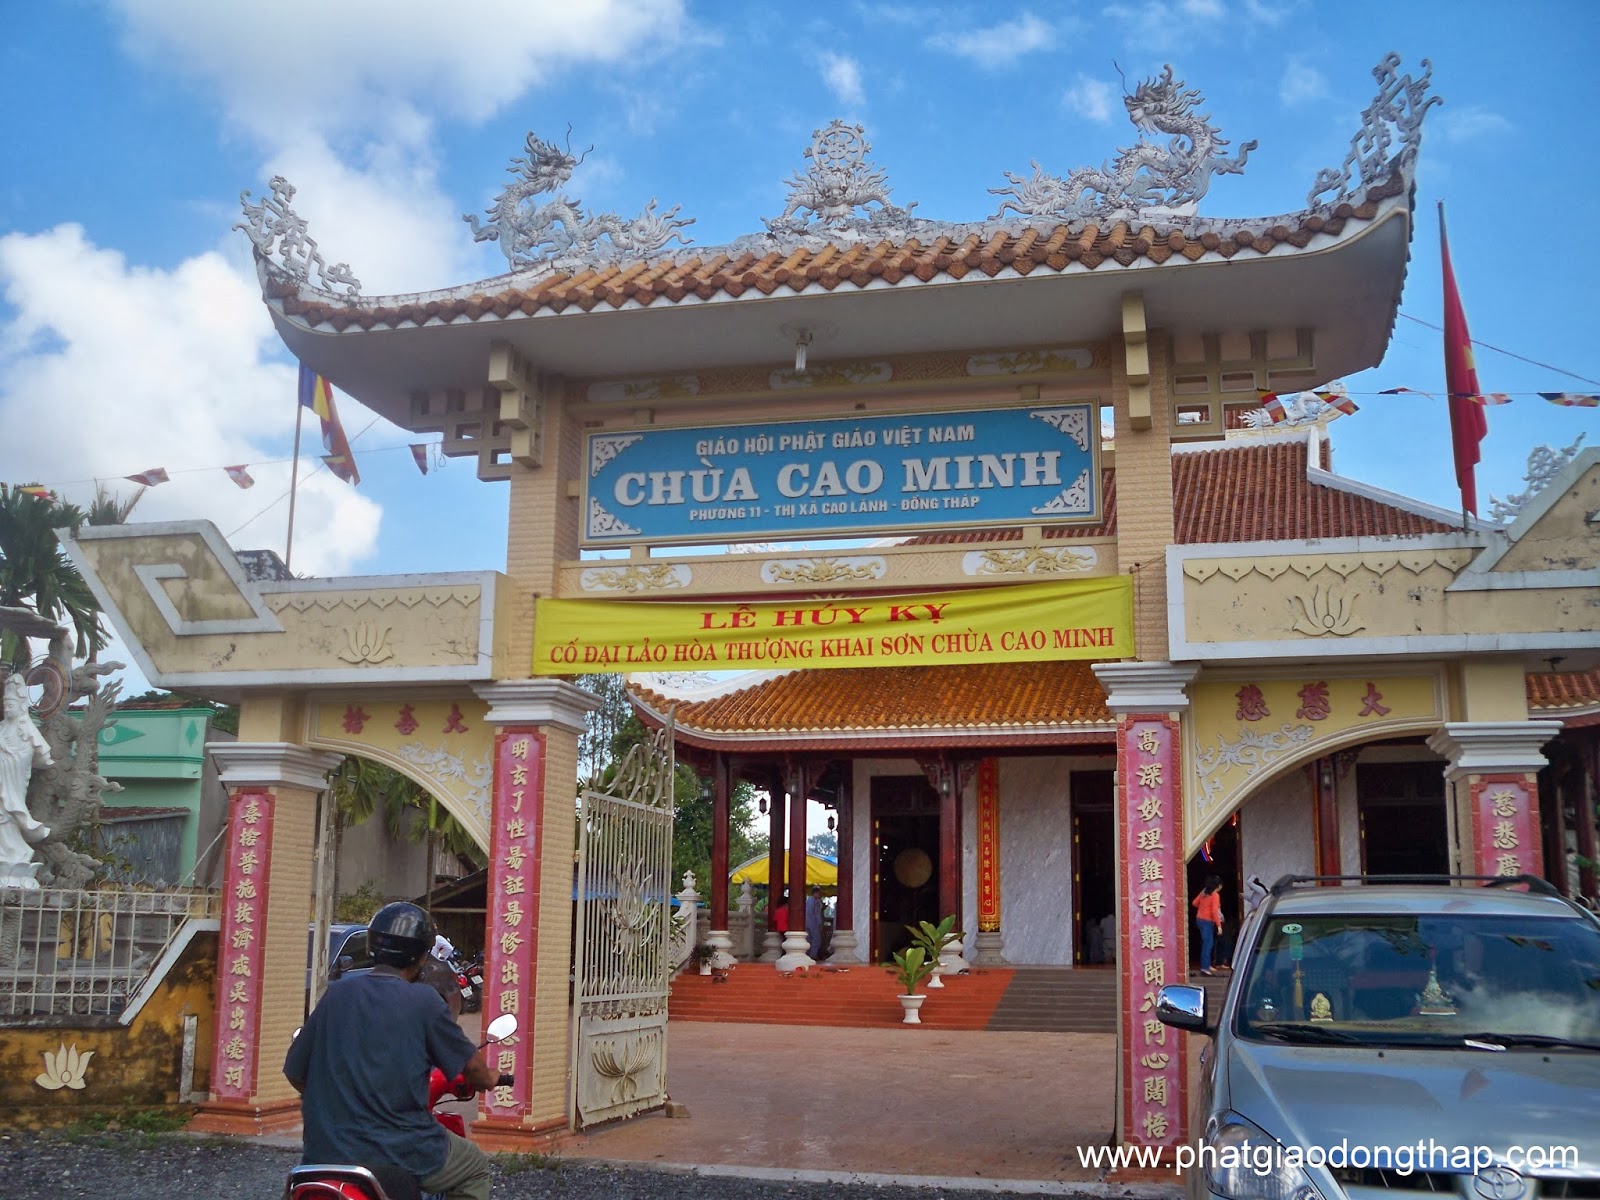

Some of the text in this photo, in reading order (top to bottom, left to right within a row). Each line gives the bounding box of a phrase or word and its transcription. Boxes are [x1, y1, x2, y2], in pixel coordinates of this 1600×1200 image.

[696, 424, 975, 456] GIÁO HỘI PHẬT GIÁO VIỆT NAM
[614, 451, 1062, 507] CHÙA CAO MINH
[689, 506, 746, 521] PHƯỜNG
[749, 506, 761, 518] 11
[774, 504, 795, 519] THỊ
[799, 500, 819, 516] XÃ
[822, 502, 848, 514] CAO
[850, 499, 888, 513] LÃNH
[901, 495, 939, 511] ĐỒNG
[943, 494, 980, 508] THÁP
[700, 603, 951, 629] LỄ HÚY KỴ
[550, 627, 1114, 667] CỐ ĐẠI LẢO HÒA THƯỢNG KHAI SƠN CHÙA CAO MINH
